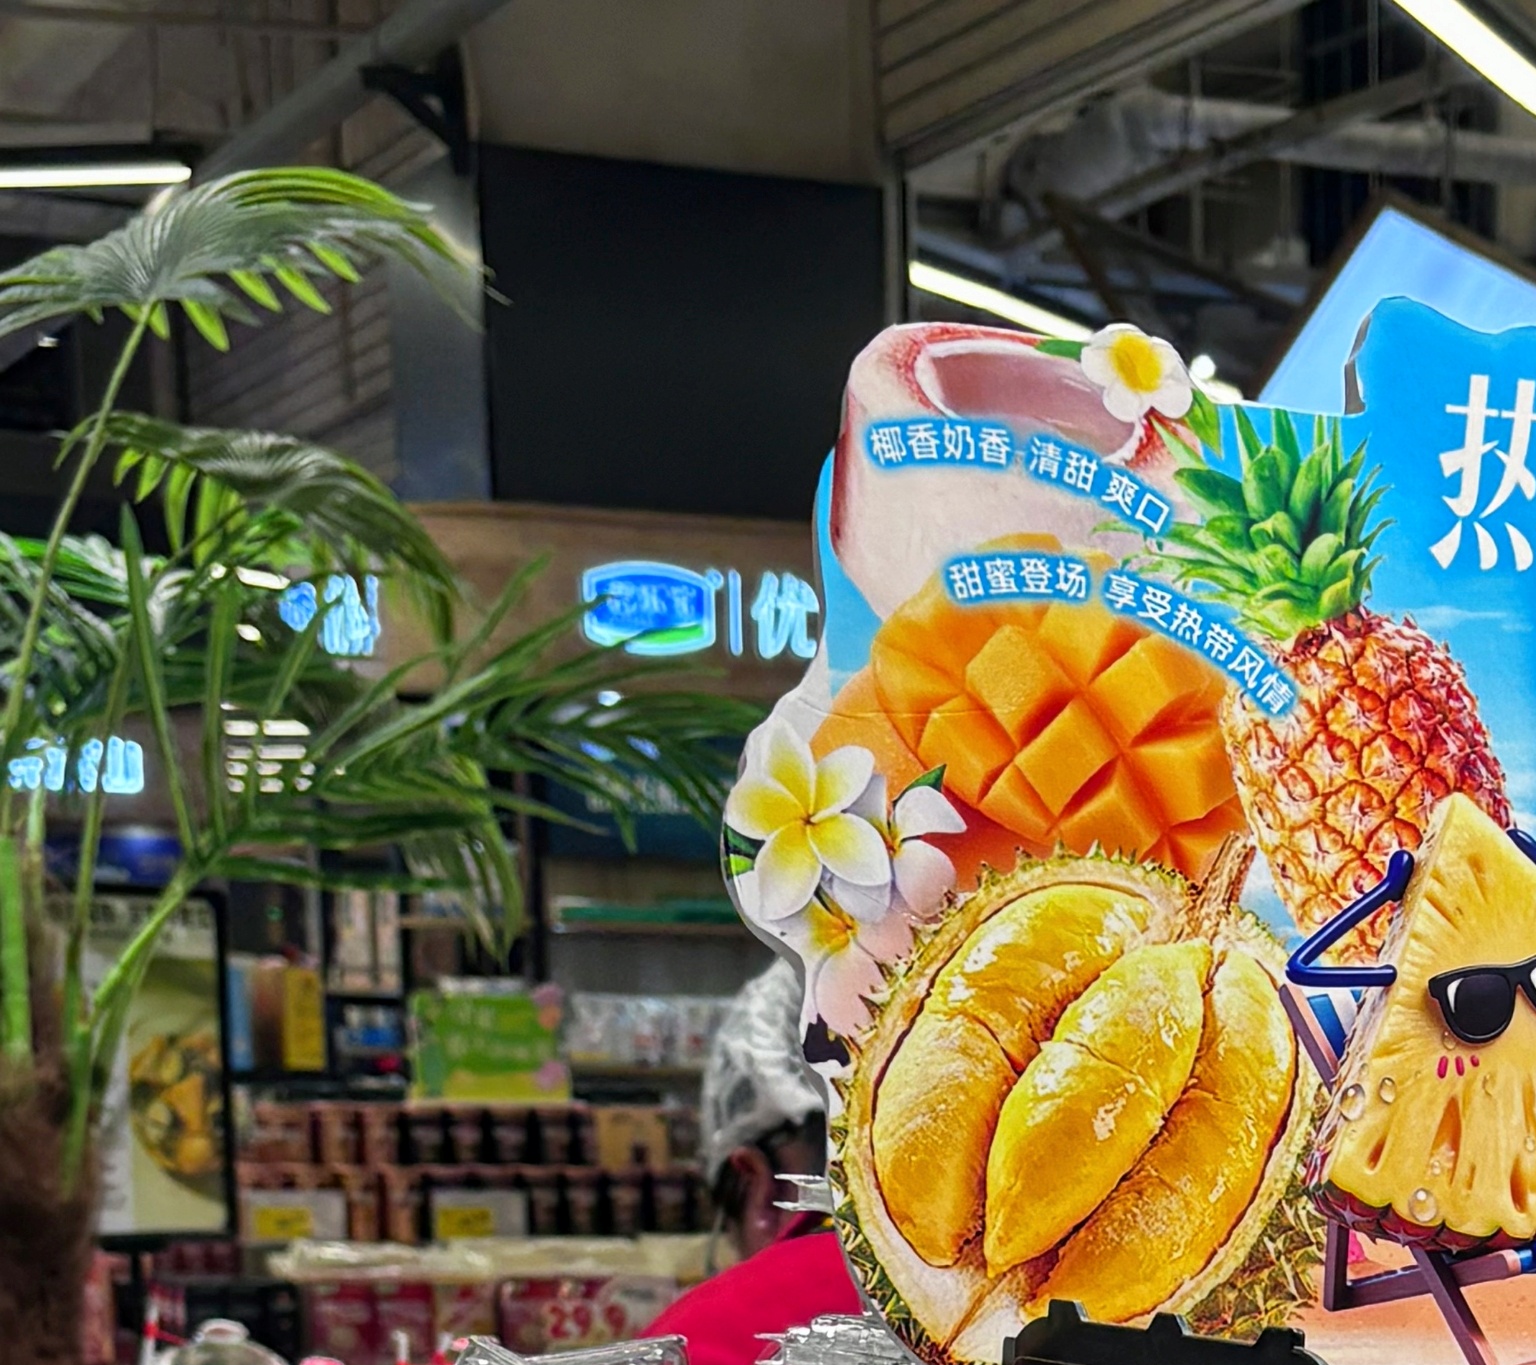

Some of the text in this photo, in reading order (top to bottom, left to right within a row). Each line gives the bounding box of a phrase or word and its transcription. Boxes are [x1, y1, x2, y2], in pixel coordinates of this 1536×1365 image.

[870, 423, 1171, 533] 椰香奶香 清甜 爽口
[948, 560, 1295, 715] 甜蜜登场 享受热带风情
